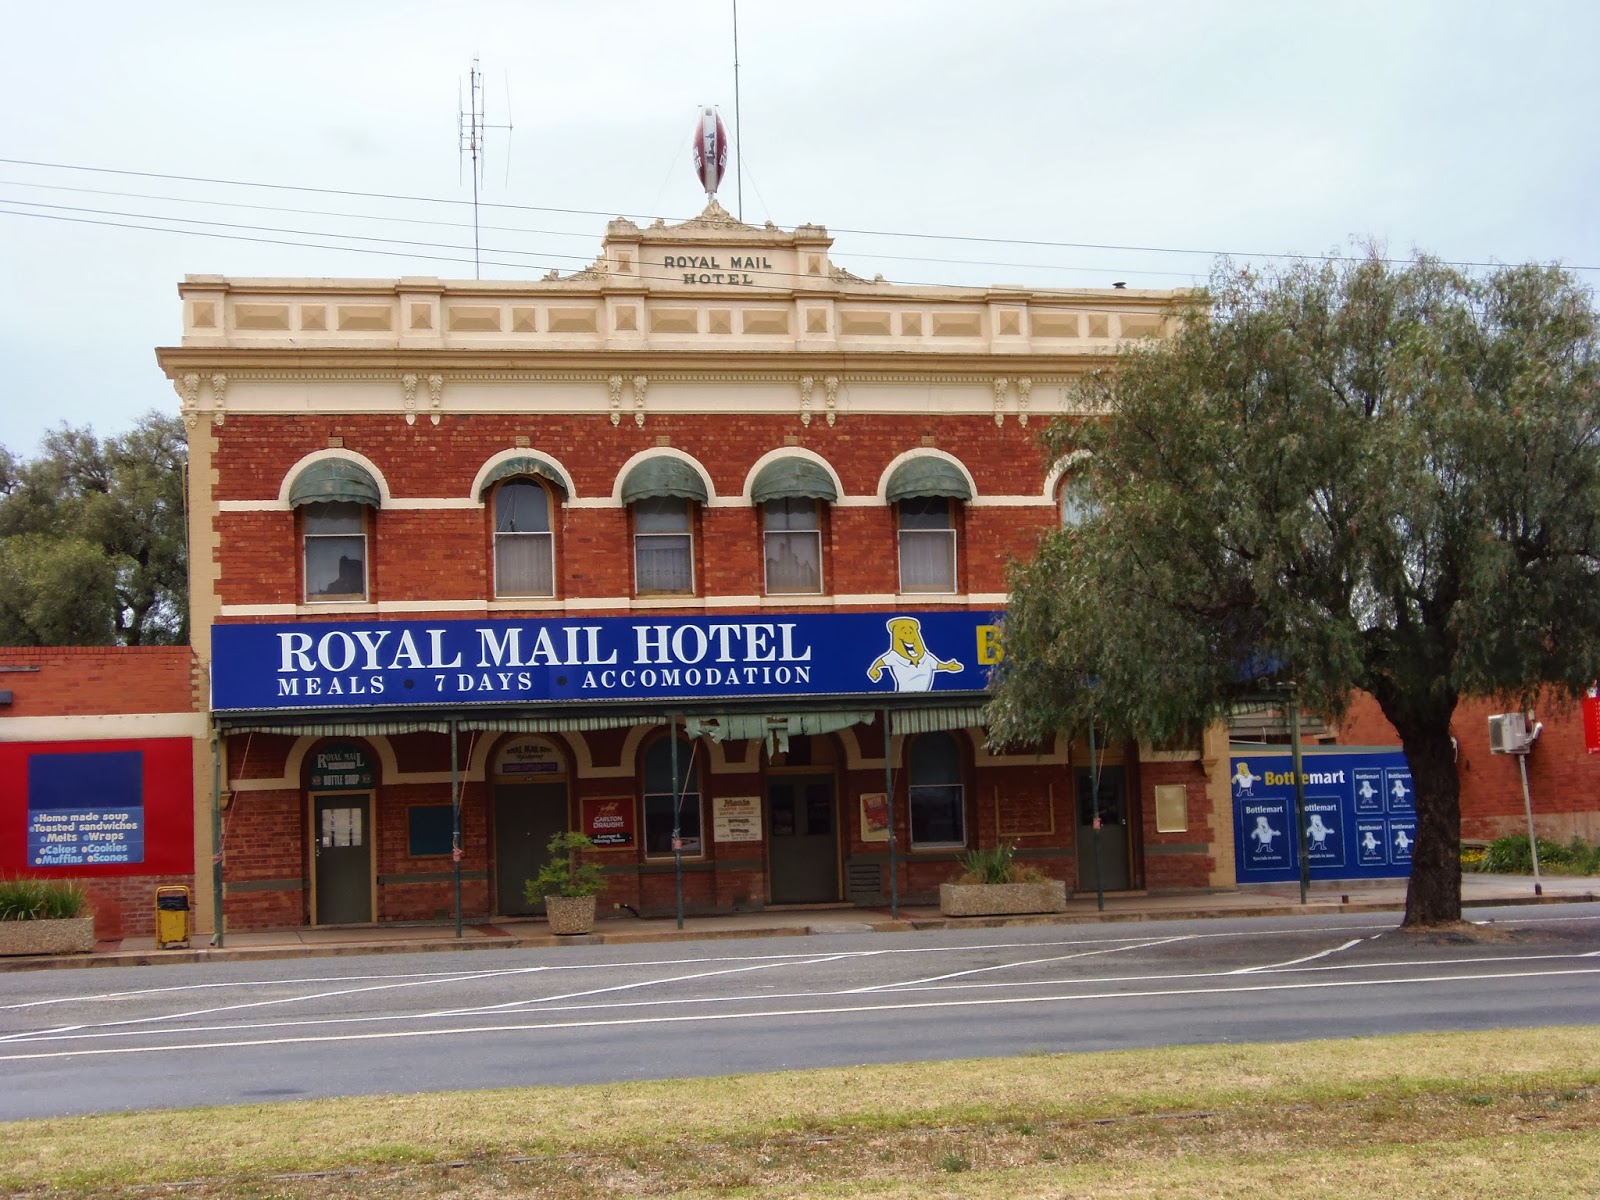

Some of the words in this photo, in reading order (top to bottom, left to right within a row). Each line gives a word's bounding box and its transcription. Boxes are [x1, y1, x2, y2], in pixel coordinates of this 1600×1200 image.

[664, 256, 720, 269] ROYAL
[730, 256, 772, 269] MAIL
[683, 273, 753, 285] HOTEL
[276, 629, 462, 673] ROYAL
[475, 626, 617, 667] MAIL
[632, 623, 812, 665] HOTEL
[277, 675, 385, 697] MEALS
[434, 674, 446, 692] 7
[457, 672, 532, 692] DAYS
[582, 666, 811, 688] ACCOMODATION
[323, 775, 343, 786] BOTTLE
[344, 774, 360, 785] SHOP
[1265, 770, 1345, 786] Bottemart
[1245, 805, 1283, 814] Bottlemart
[1304, 804, 1337, 812] ottlemart
[39, 814, 68, 822] Home
[70, 812, 99, 821] made
[102, 813, 129, 822] soup
[33, 822, 75, 832] Toasted
[79, 821, 138, 831] sandwiches
[46, 833, 78, 842] Melts
[88, 832, 124, 842] Wraps
[45, 844, 77, 854] Cakes
[87, 843, 128, 853] Cookies
[41, 854, 83, 864] Muffins
[92, 853, 128, 862] Scones
